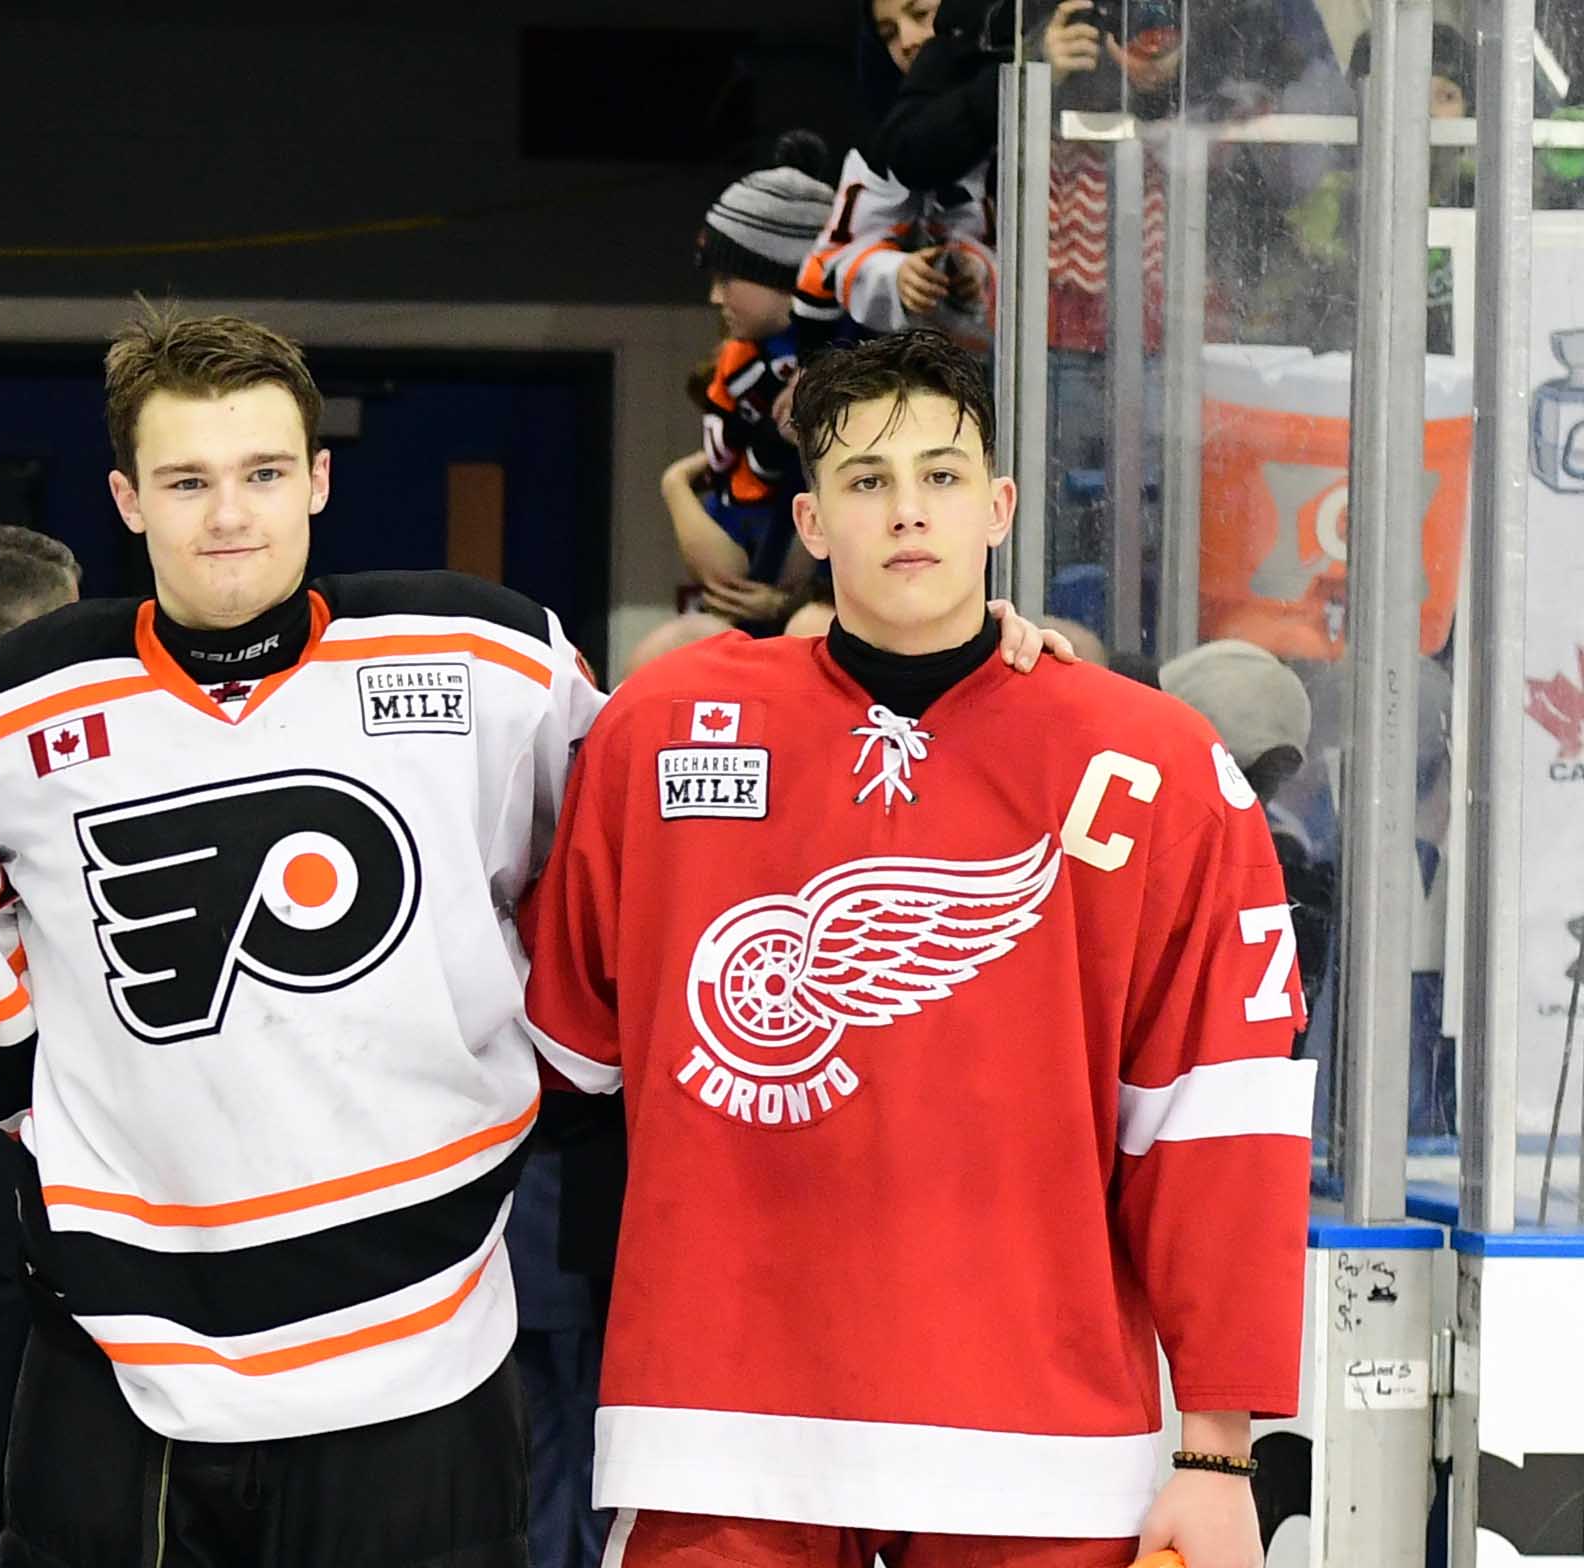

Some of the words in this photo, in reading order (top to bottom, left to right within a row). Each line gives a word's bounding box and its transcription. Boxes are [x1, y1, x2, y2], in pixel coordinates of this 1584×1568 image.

[366, 672, 443, 689] RECHARGE
[370, 694, 463, 720] MILK
[664, 757, 738, 773] RECHARGE
[665, 778, 758, 805] MILK
[1061, 750, 1162, 872] C
[1238, 903, 1309, 1024] 7
[676, 1045, 860, 1125] TORONTO
